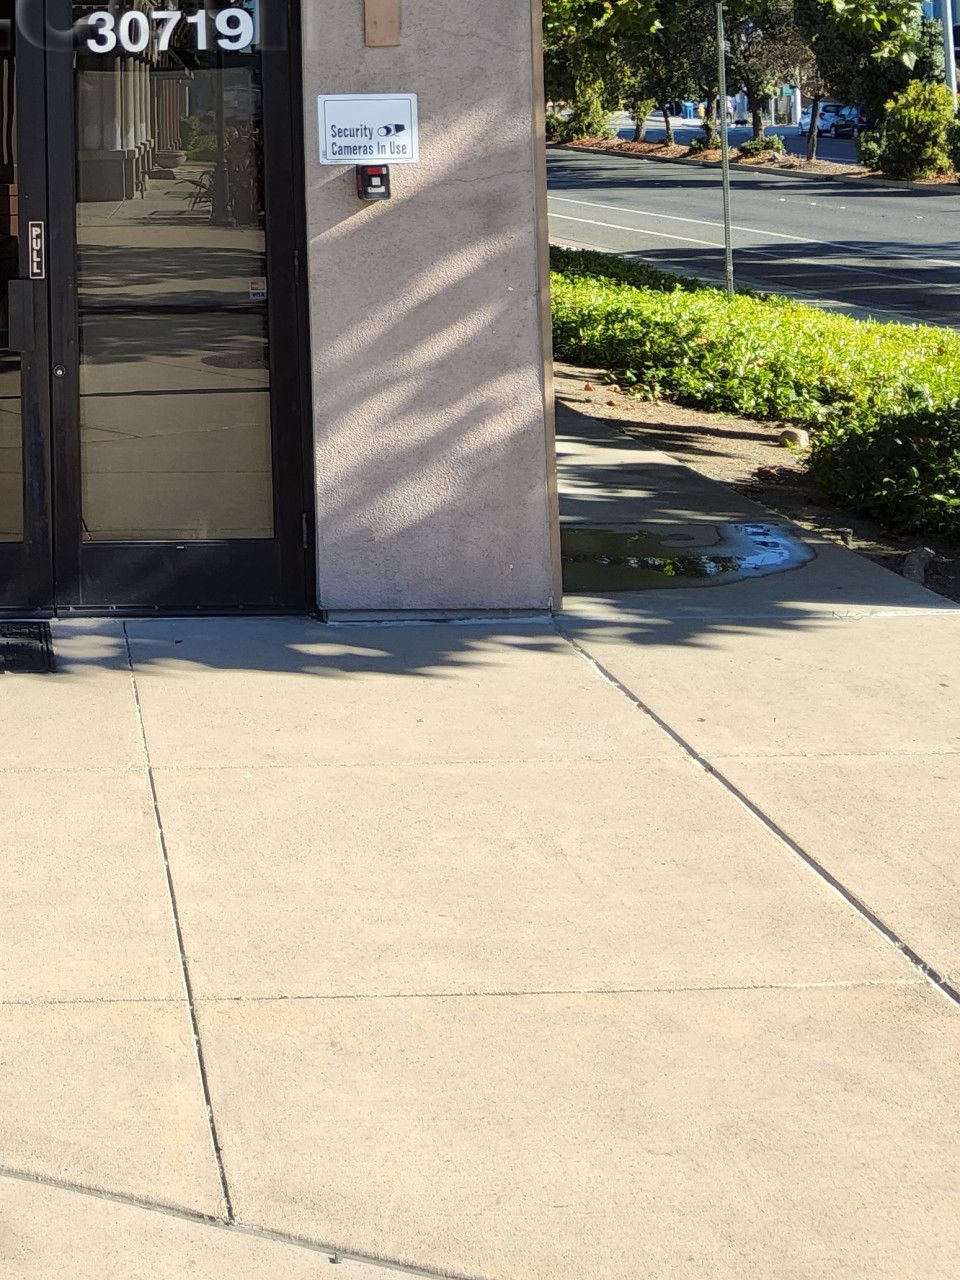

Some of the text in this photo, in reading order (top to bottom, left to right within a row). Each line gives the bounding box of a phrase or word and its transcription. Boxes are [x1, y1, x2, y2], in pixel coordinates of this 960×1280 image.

[87, 6, 254, 54] 30719
[331, 124, 374, 140] Security
[331, 142, 374, 156] Cameras
[377, 141, 386, 155] In
[390, 141, 407, 155] Use
[32, 227, 41, 273] PULL
